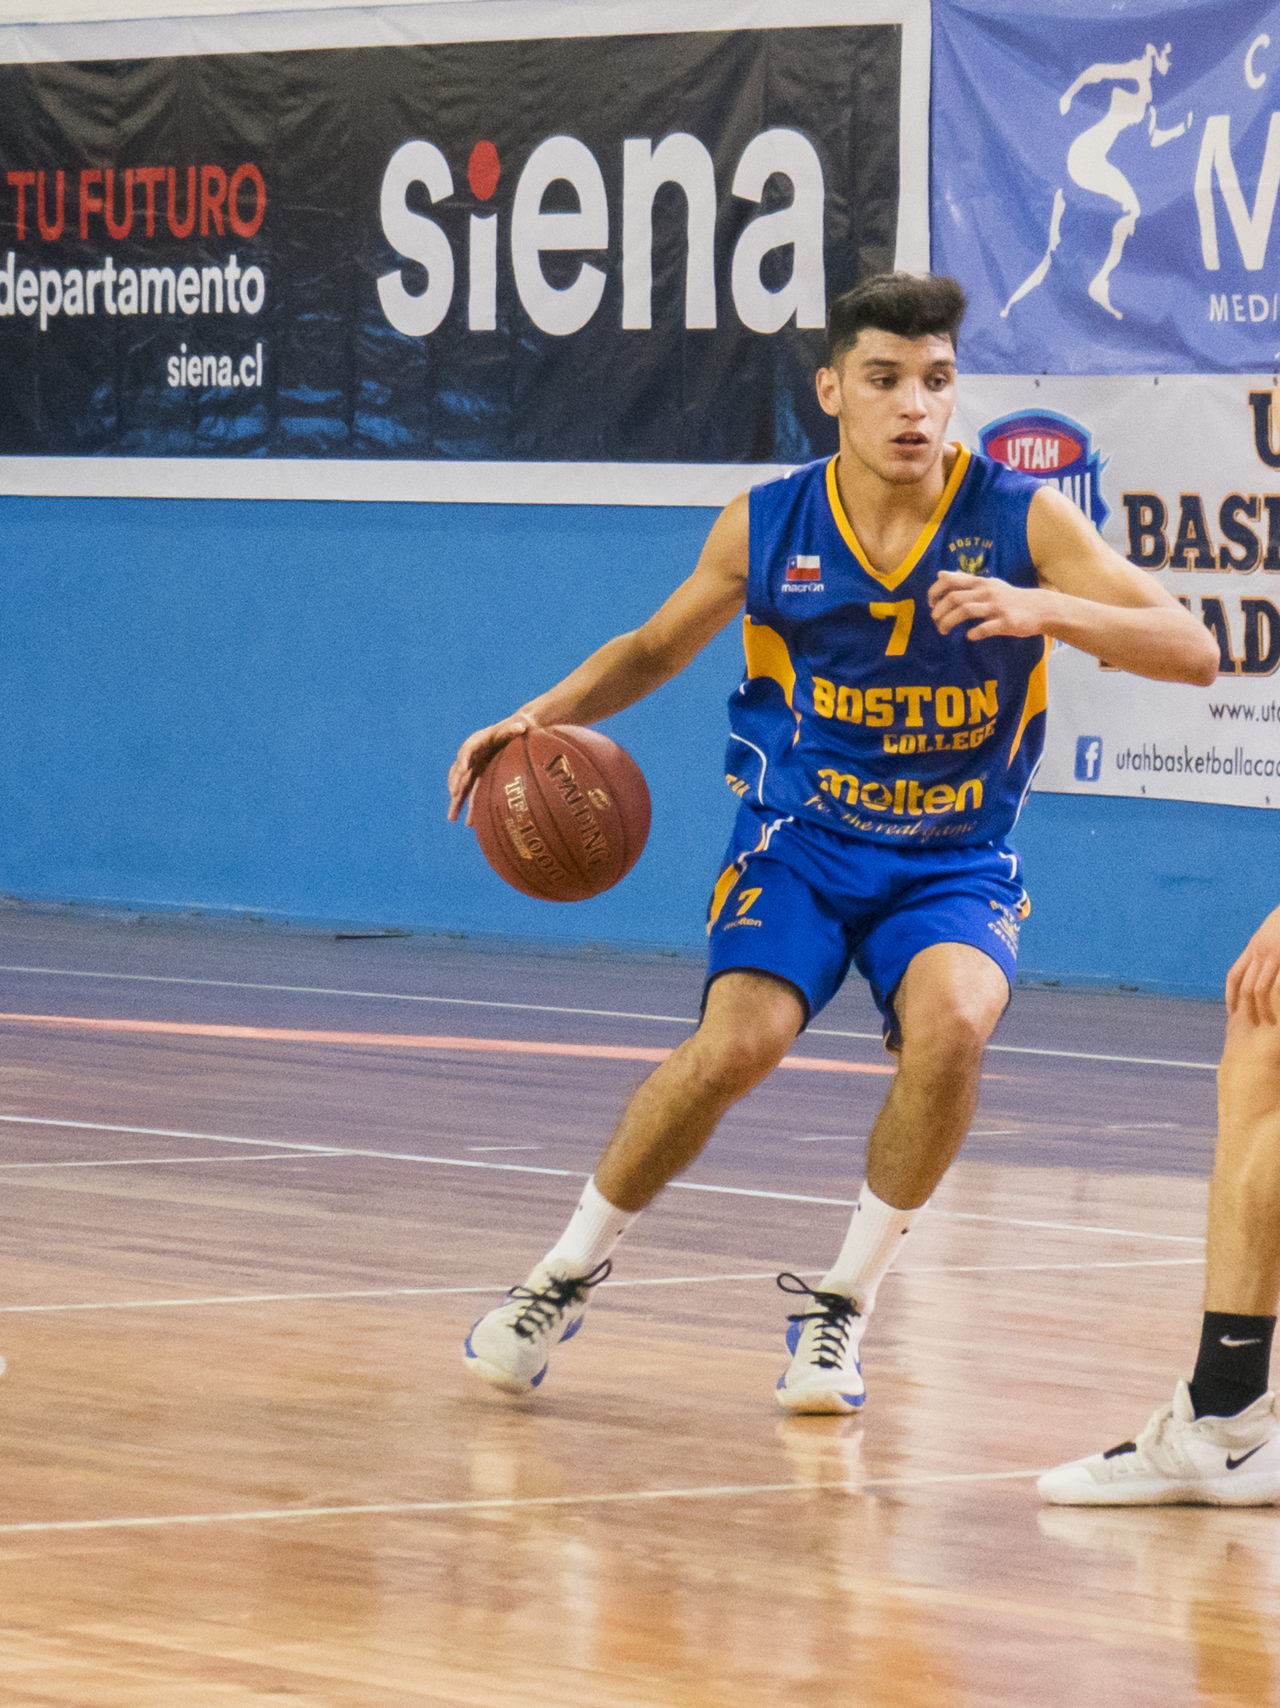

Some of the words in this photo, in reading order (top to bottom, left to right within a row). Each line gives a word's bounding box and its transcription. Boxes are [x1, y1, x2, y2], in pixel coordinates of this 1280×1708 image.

[7, 170, 64, 241] TU
[79, 162, 266, 240] FUTURO
[376, 128, 826, 338] siena
[0, 251, 265, 331] departamento
[167, 343, 263, 387] siena.cl
[1007, 436, 1060, 469] UTAH
[869, 599, 915, 657] 7
[811, 676, 999, 728] BOSTON
[883, 719, 998, 755] COLLEGE
[543, 753, 613, 869] SPALDING
[817, 768, 984, 816] molten
[736, 887, 764, 917] 7
